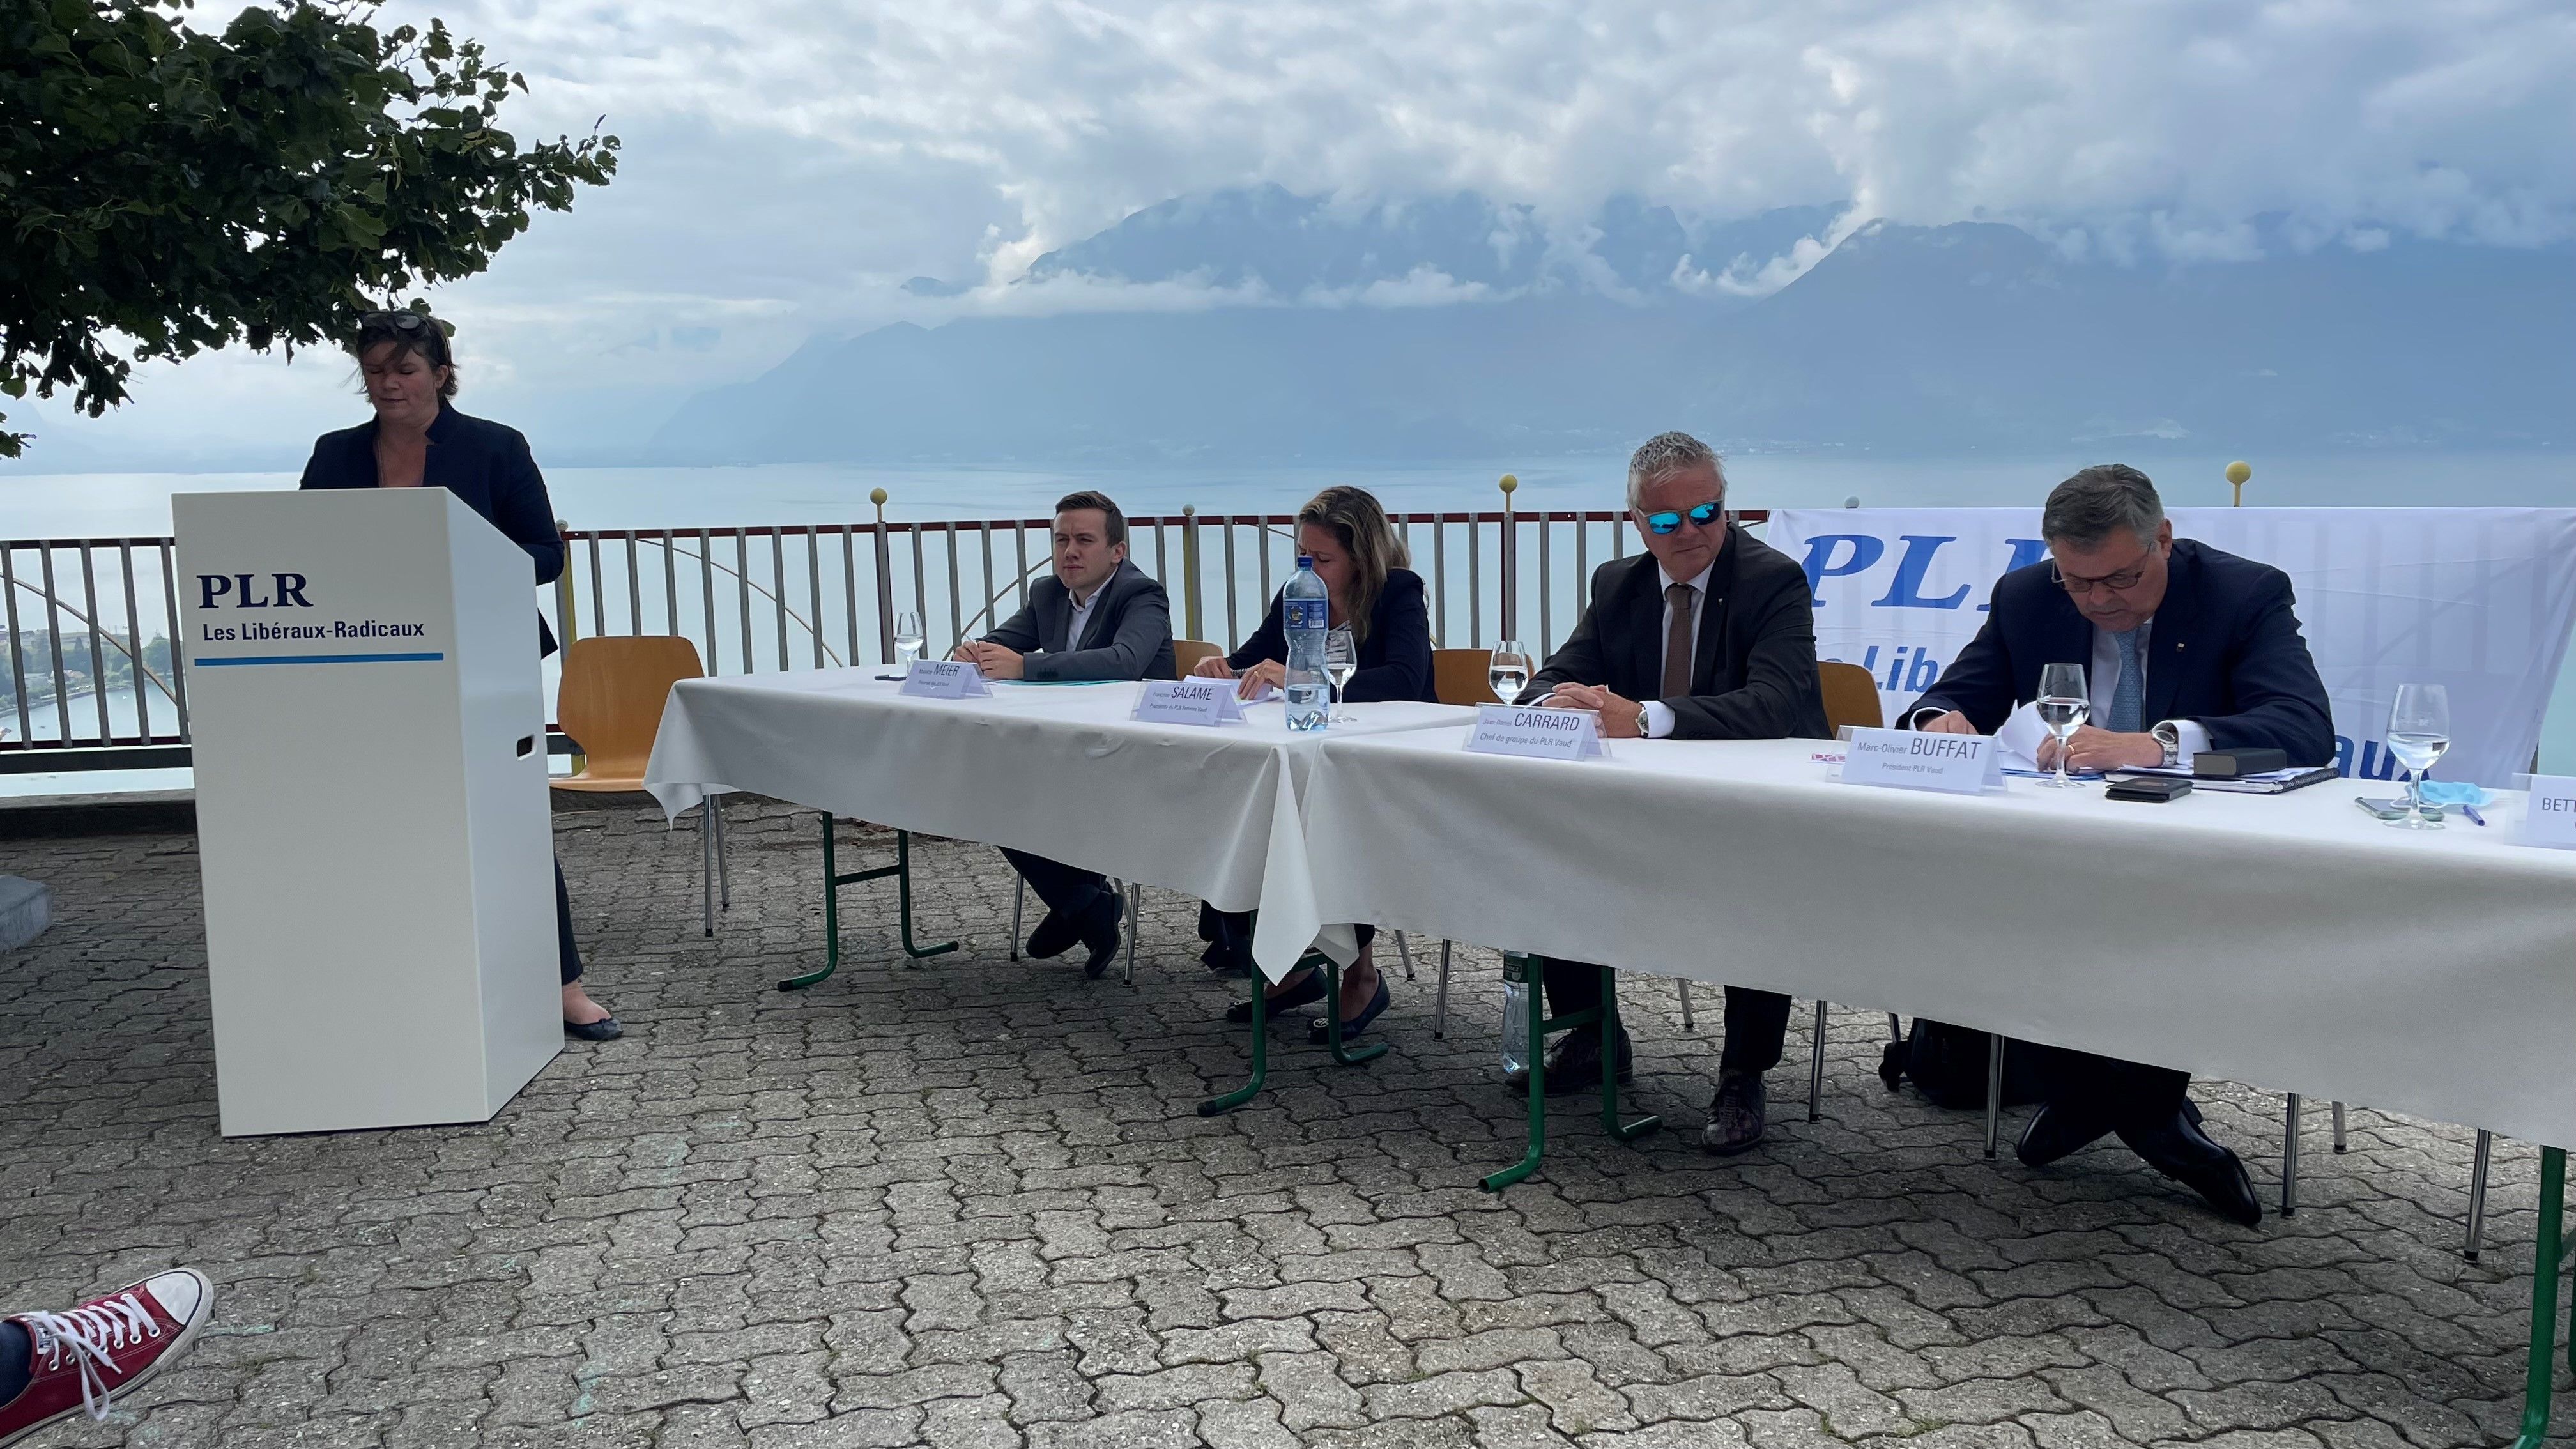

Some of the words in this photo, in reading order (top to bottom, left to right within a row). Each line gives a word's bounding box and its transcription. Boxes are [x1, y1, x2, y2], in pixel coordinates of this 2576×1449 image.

[196, 572, 314, 610] PLR
[203, 624, 236, 641] Les
[241, 620, 425, 640] Libéraux-Radicaux
[933, 664, 960, 677] MEIER
[1170, 685, 1215, 701] SALAMÉ
[1514, 712, 1581, 731] CARRARD
[1480, 732, 1496, 741] Chef
[1505, 736, 1529, 745] groupe
[1539, 737, 1554, 746] PLR
[1554, 738, 1572, 747] Vaud
[1857, 742, 1908, 755] Marc-Olivier
[1910, 737, 1982, 760] BUFFAT
[1912, 765, 1926, 773] PLR
